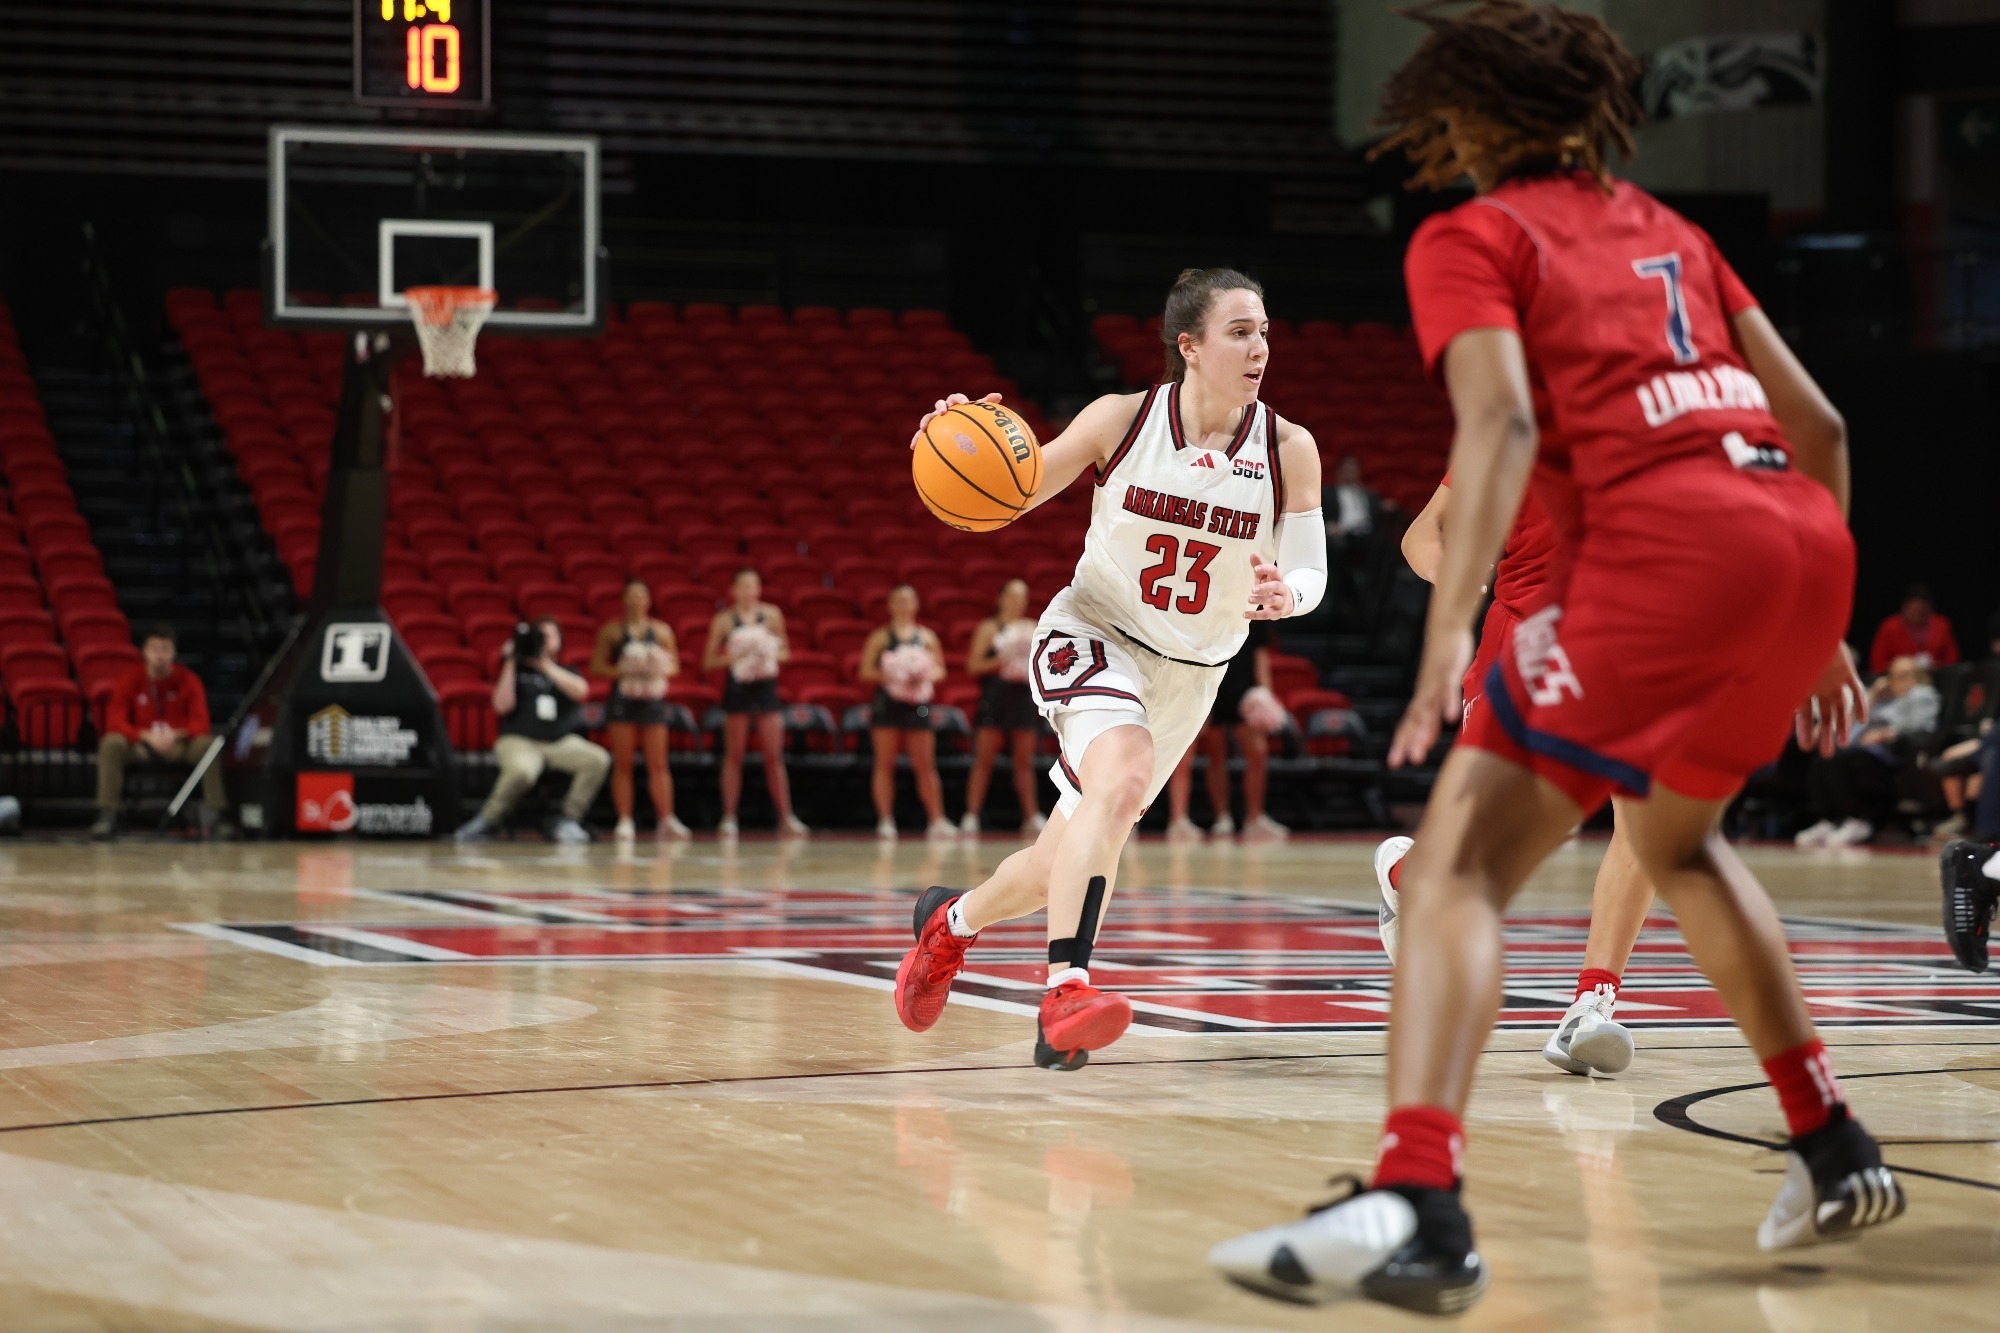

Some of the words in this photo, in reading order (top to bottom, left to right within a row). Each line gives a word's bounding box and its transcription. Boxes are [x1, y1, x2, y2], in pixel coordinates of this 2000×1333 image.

[407, 24, 460, 93] 10
[1631, 251, 1699, 366] 7
[1232, 458, 1265, 480] SBC
[1122, 485, 1208, 530] ARKANSAS
[1207, 506, 1261, 540] STATE
[1140, 533, 1222, 615] 23
